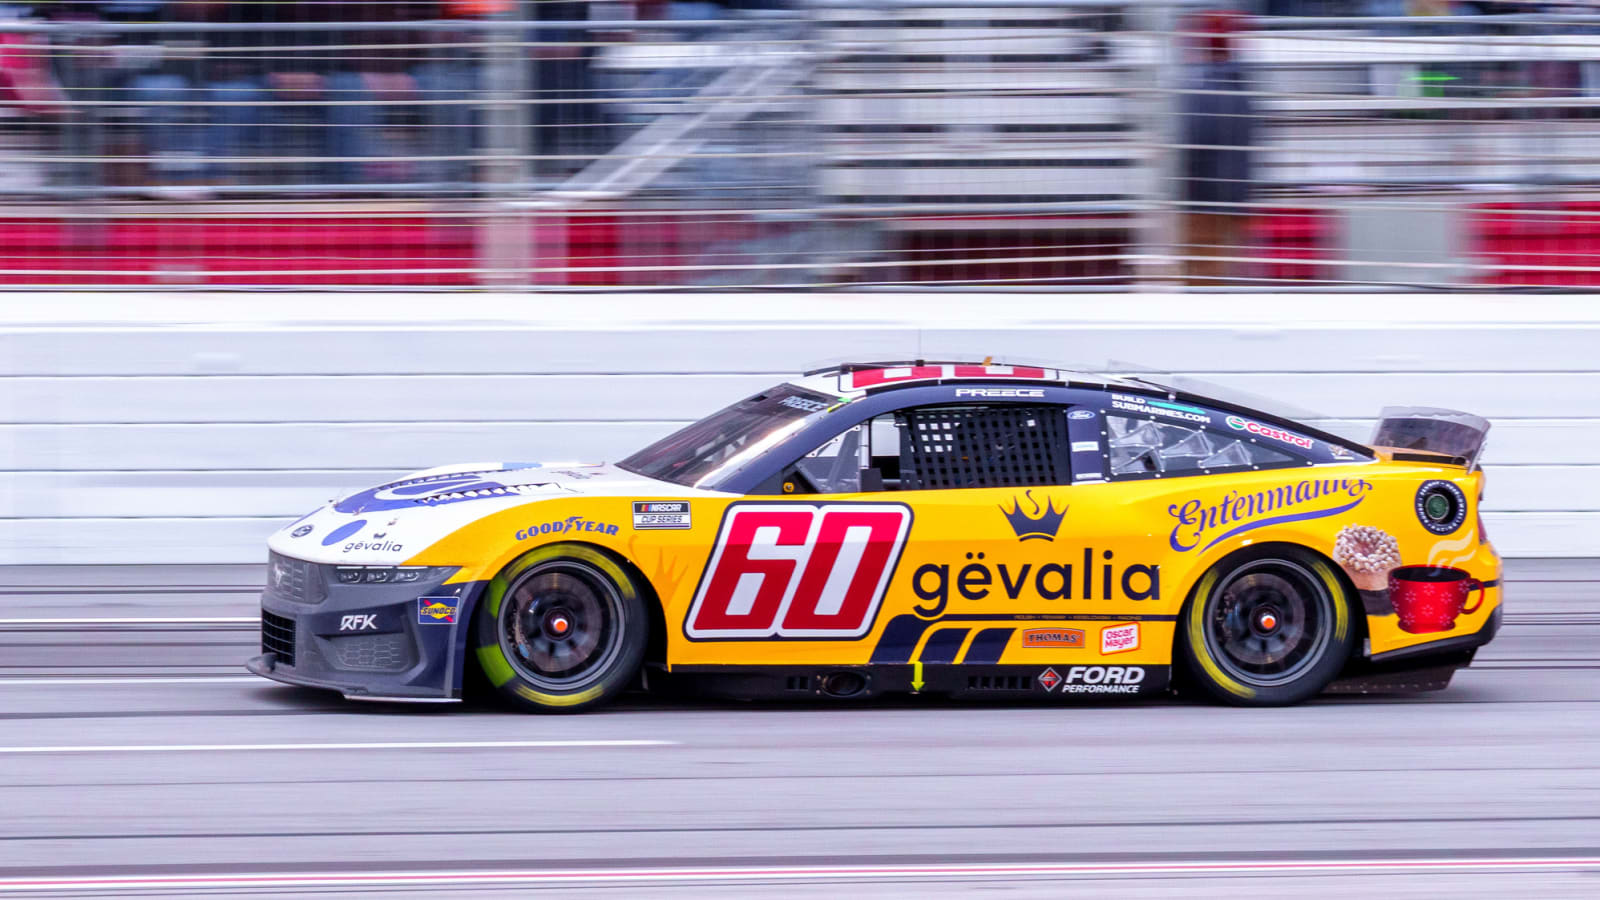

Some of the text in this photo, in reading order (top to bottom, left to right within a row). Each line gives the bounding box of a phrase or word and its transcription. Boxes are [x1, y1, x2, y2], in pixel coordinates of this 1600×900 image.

[956, 388, 1045, 397] PREECE
[1111, 393, 1146, 404] BUILD
[1111, 400, 1212, 424] SUBMARINES.COM
[1246, 422, 1313, 449] Castrol
[651, 503, 682, 512] NASCAR
[1168, 477, 1373, 553] Entenmanns
[641, 515, 683, 524] CUP SERIES
[515, 516, 620, 541] GOODYEAR
[684, 503, 913, 640] 60
[911, 547, 1161, 618] gëvalia
[421, 606, 457, 616] SUNOCO
[340, 614, 378, 631] RFK
[1105, 627, 1134, 640] Oscar
[1104, 635, 1136, 649] Mayer
[1065, 666, 1146, 684] FORD
[1062, 684, 1141, 694] PERFORMANCE
